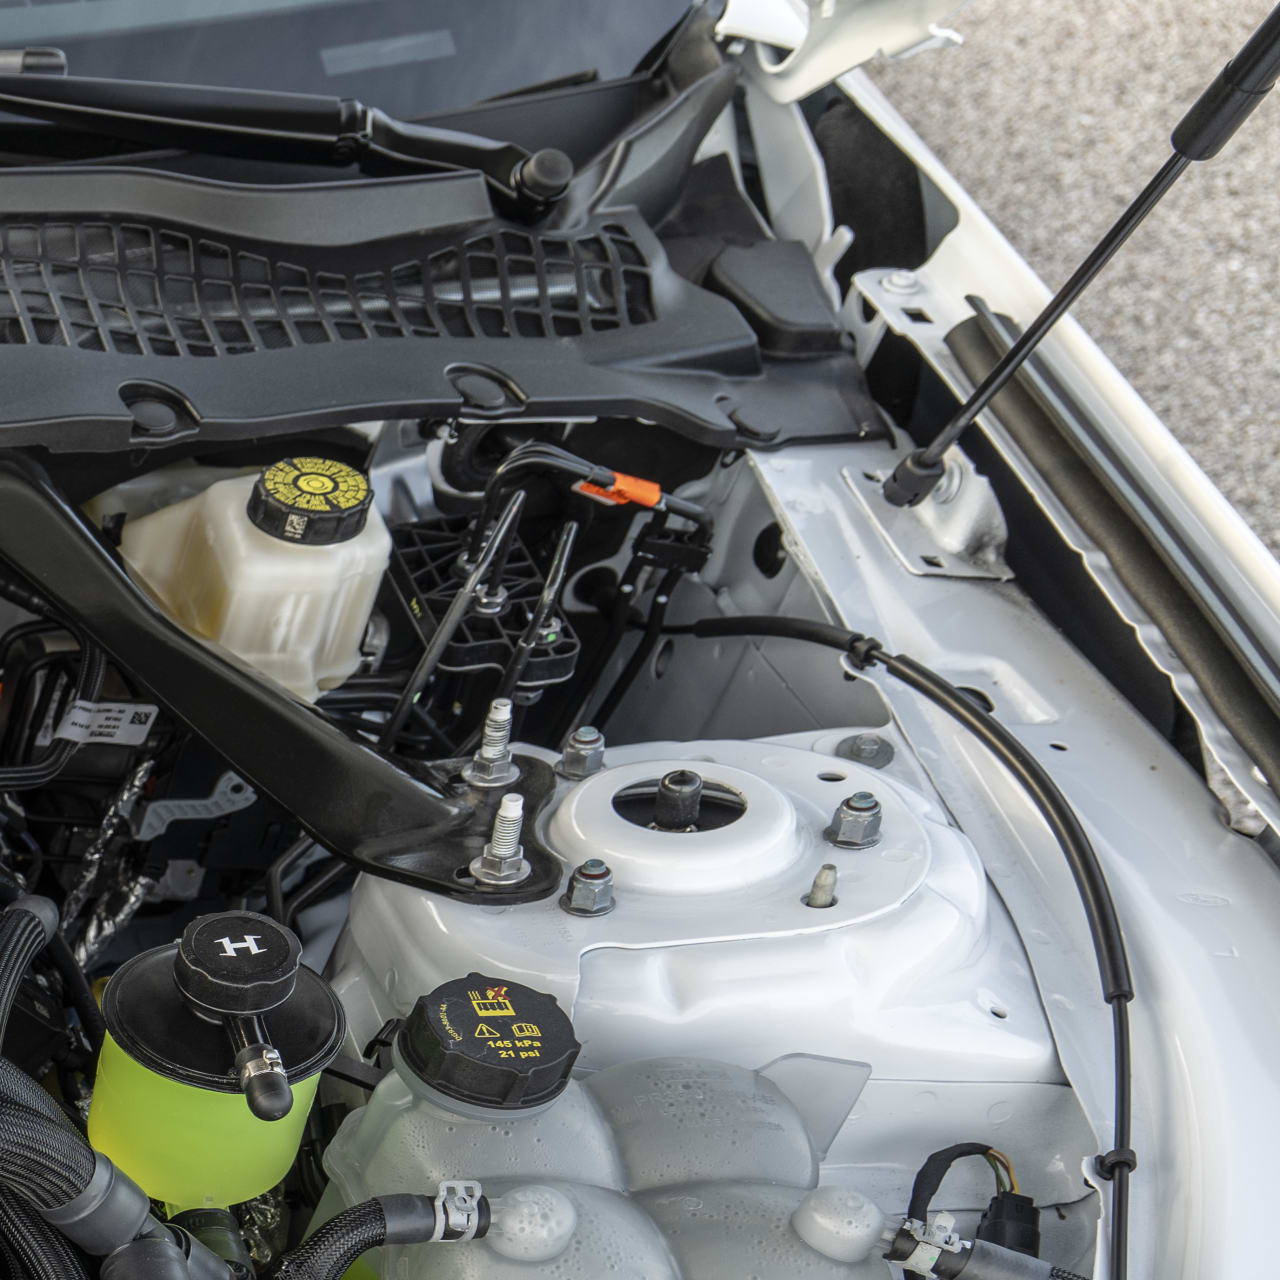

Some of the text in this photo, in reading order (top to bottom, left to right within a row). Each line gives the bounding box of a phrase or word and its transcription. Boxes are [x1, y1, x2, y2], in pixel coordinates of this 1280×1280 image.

[213, 935, 268, 957] H
[488, 1039, 542, 1048] 145 kPa
[498, 1050, 540, 1059] 21 psi
